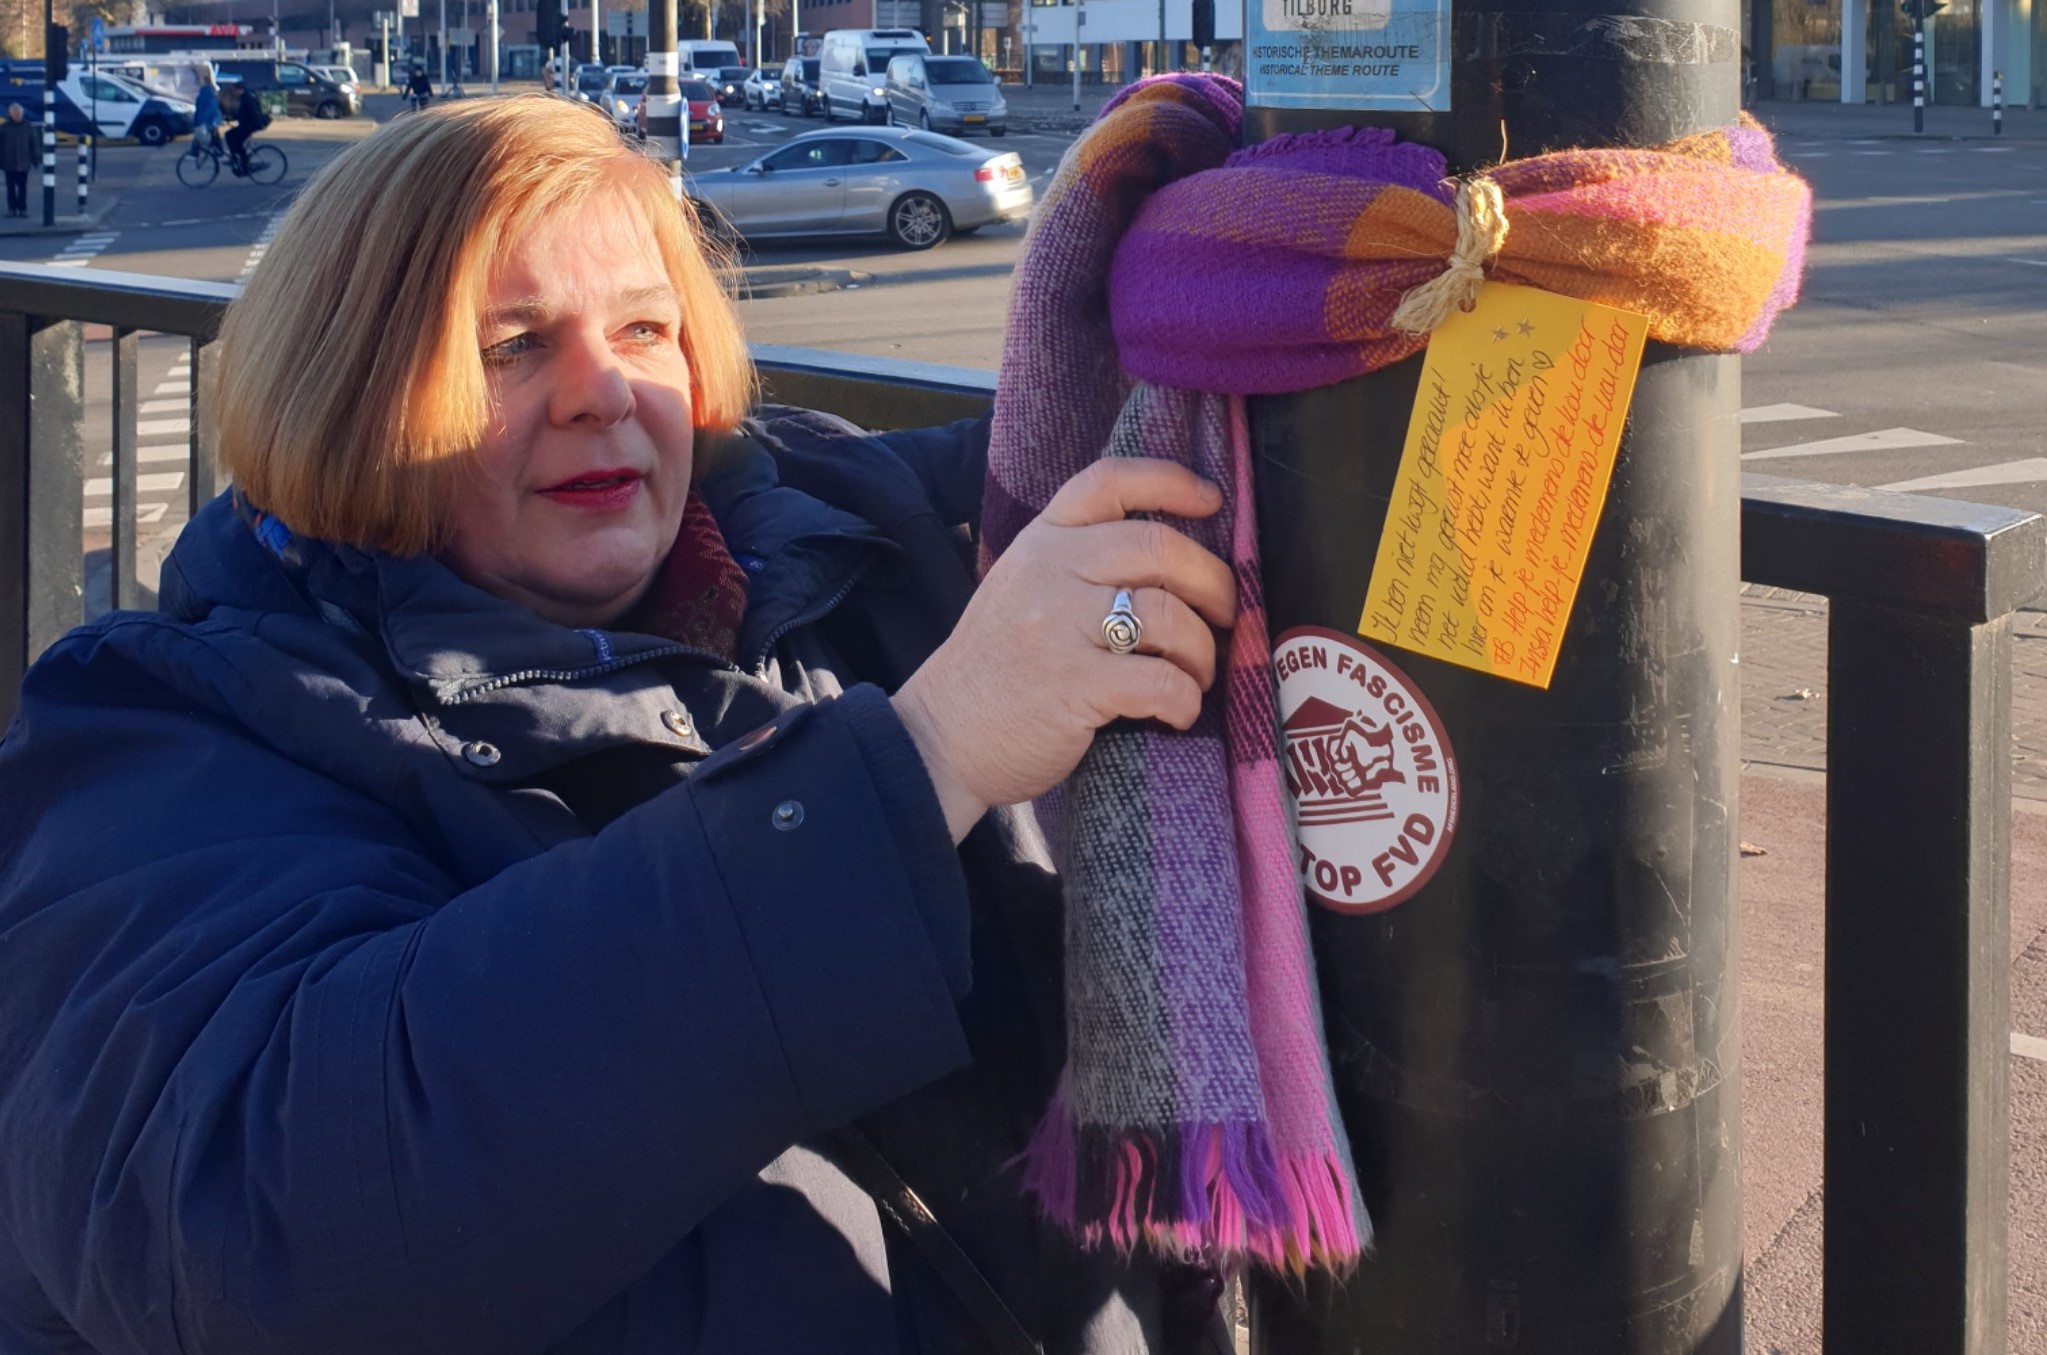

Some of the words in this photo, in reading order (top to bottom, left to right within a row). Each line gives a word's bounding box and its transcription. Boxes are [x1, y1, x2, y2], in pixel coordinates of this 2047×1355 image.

[1282, 0, 1353, 17] TILBURG
[1252, 45, 1310, 60] HISTORISCHE
[1314, 44, 1420, 59] THEMAROUTE
[1259, 64, 1307, 76] HISTORICAL
[1310, 65, 1349, 77] THEME
[1351, 65, 1400, 77] ROUTE
[1476, 429, 1505, 489] want
[1497, 357, 1524, 401] ben
[1522, 374, 1552, 457] geven
[1452, 430, 1476, 480] mee
[1500, 591, 1534, 636] Help
[1525, 455, 1565, 568] medemens
[1545, 424, 1574, 457] de
[1568, 314, 1596, 380] door
[1390, 530, 1415, 577] niet
[1381, 578, 1409, 615] ben
[1370, 610, 1400, 643] Ik
[1275, 645, 1328, 682] EGEN
[1336, 652, 1440, 794] FASCISME
[1299, 843, 1362, 897] TOP
[1371, 812, 1436, 888] FVD
